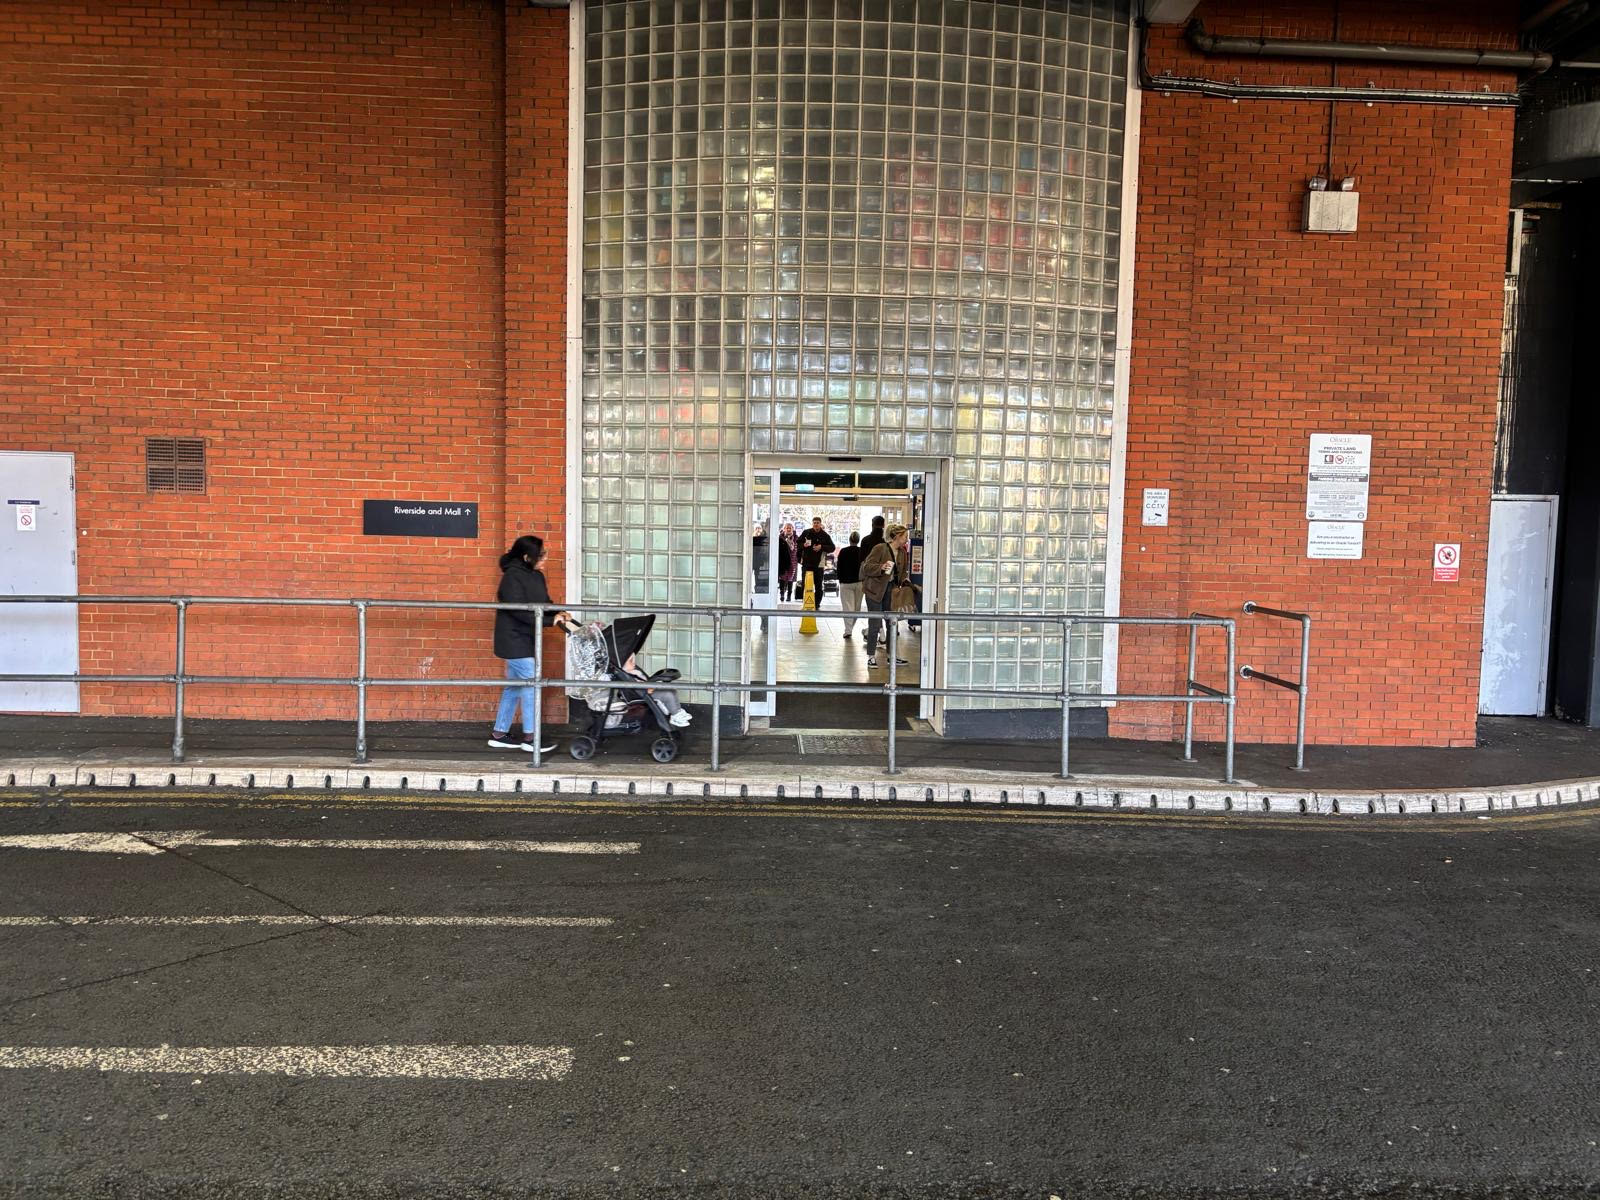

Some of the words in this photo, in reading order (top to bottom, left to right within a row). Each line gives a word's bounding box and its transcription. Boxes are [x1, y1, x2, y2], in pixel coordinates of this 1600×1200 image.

[394, 506, 426, 515] Riverside
[427, 507, 442, 516] and
[444, 508, 462, 516] Mall
